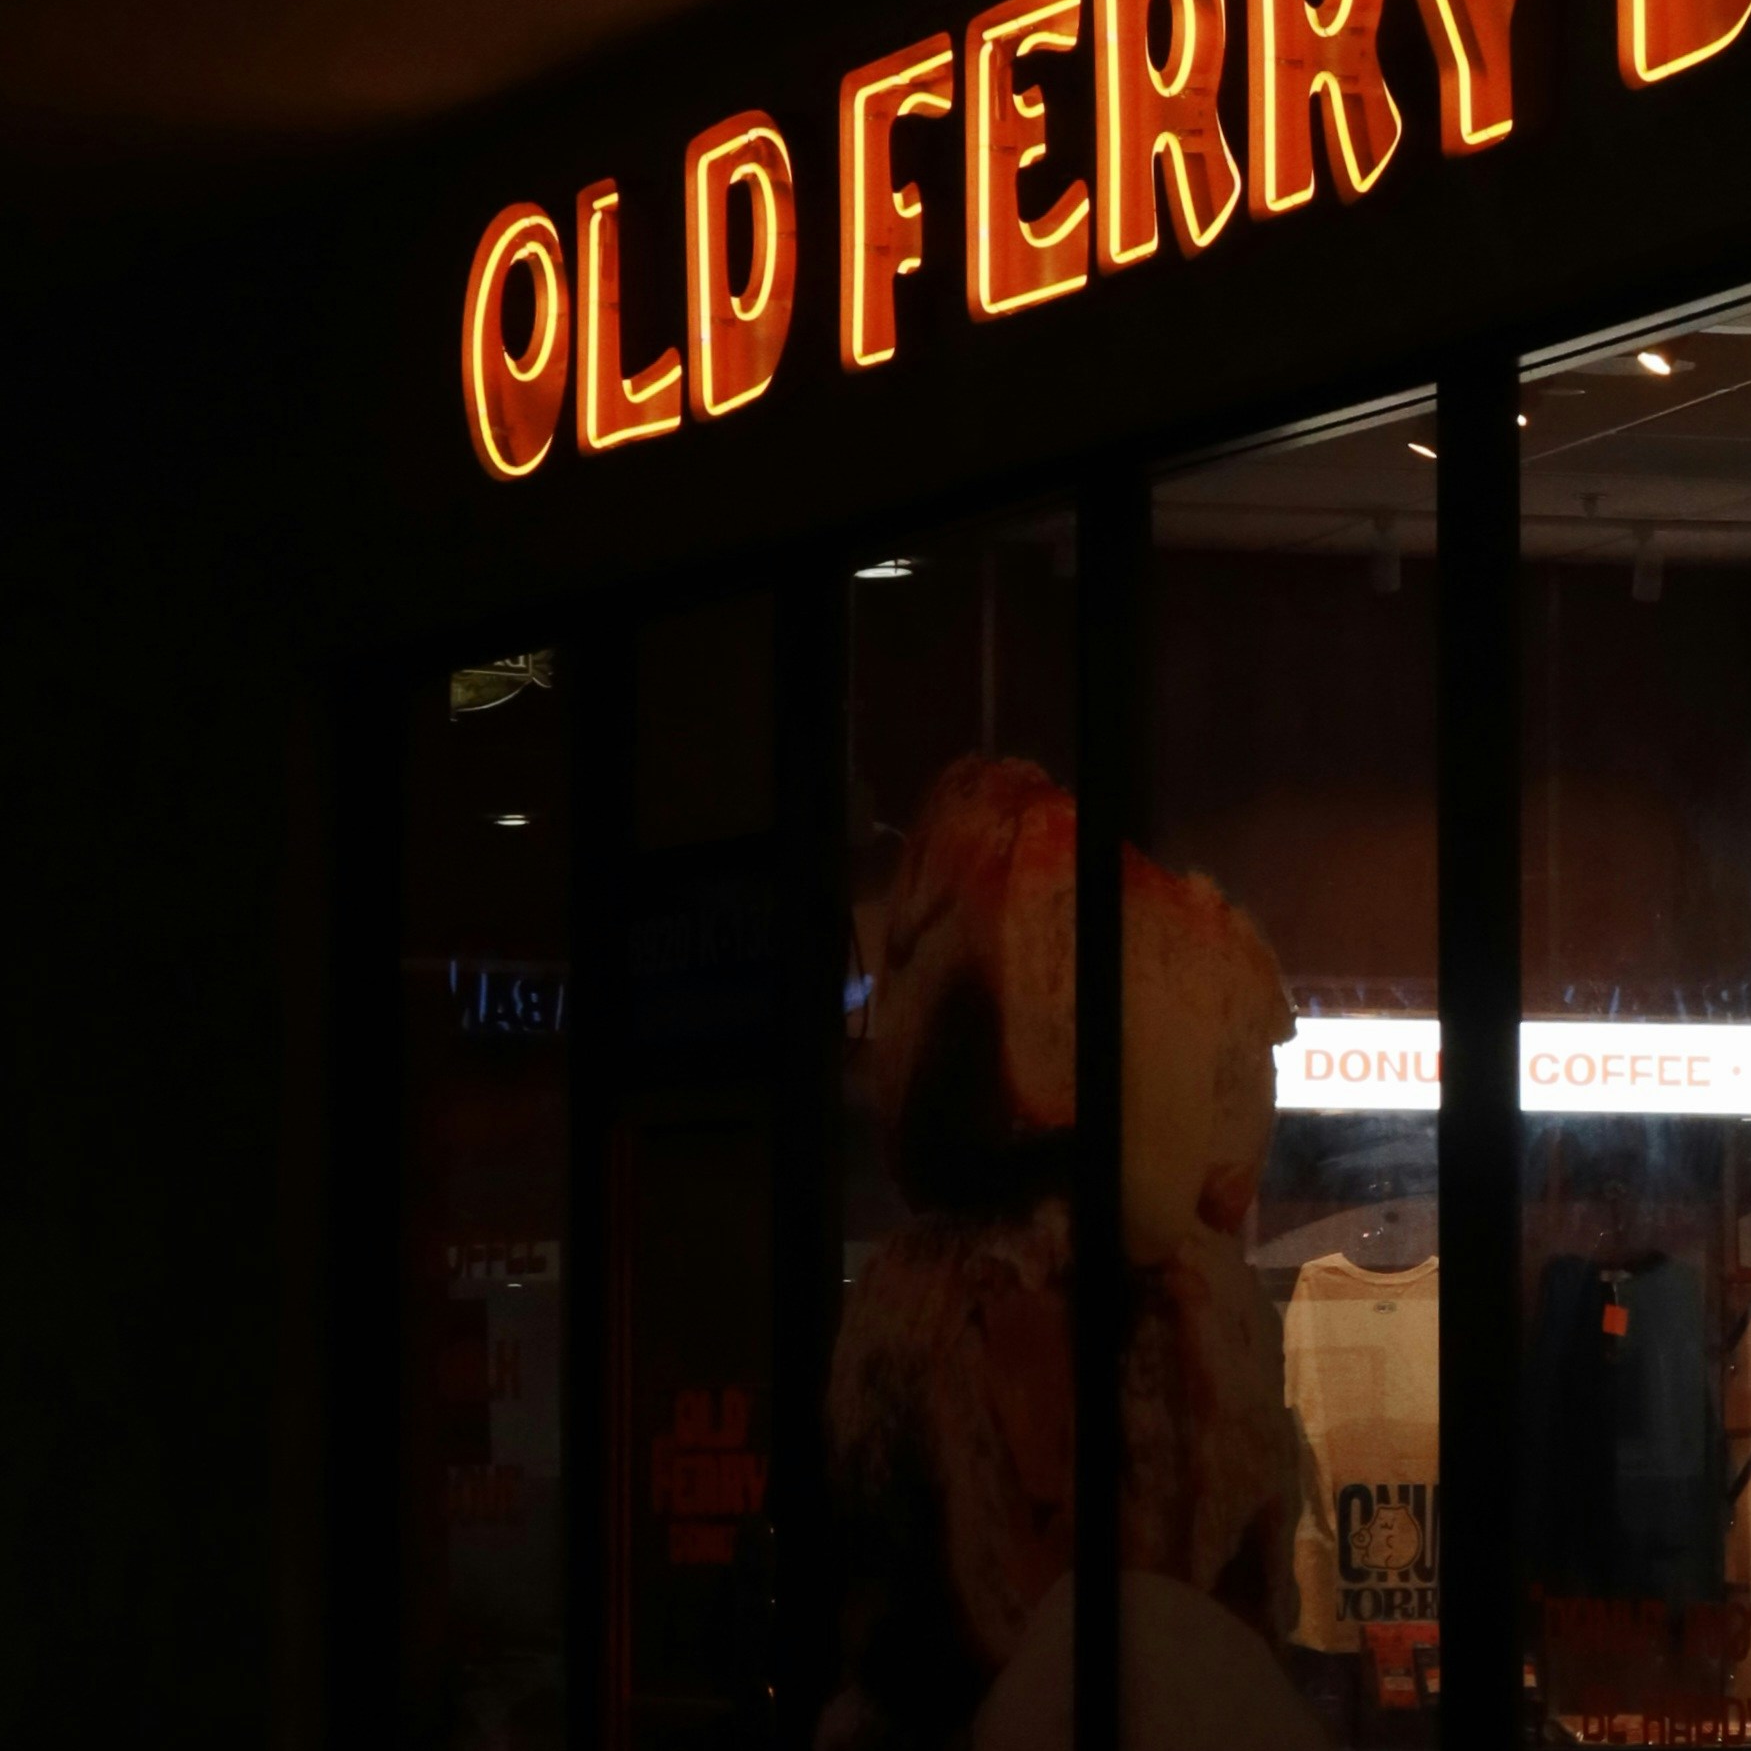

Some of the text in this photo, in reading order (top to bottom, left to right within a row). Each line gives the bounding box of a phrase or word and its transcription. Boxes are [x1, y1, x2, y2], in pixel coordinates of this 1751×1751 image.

[462, 110, 798, 481] OLD
[1303, 1048, 1441, 1084] DONU
[1528, 1052, 1711, 1087] COFFEE
